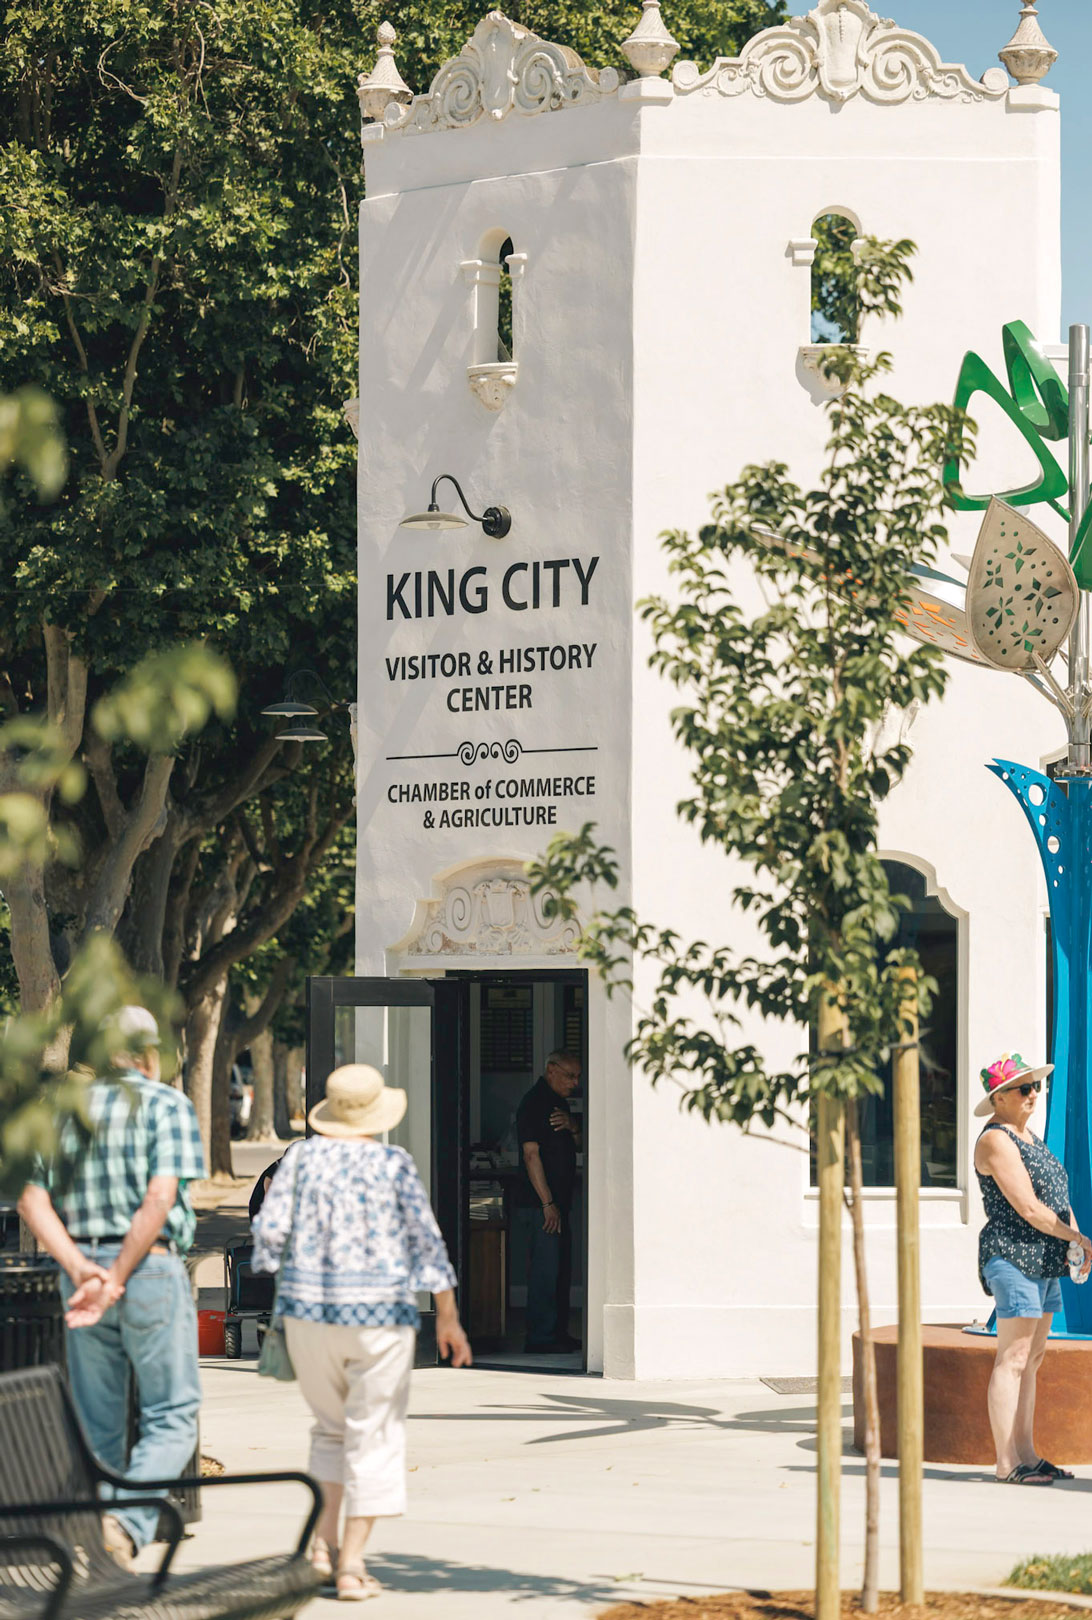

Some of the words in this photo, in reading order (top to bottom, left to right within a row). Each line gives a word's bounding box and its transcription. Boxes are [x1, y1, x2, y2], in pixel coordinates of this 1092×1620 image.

[387, 566, 488, 620] KING
[502, 557, 599, 611] CITY
[386, 652, 471, 681] VISITOR
[477, 651, 493, 675] &
[500, 643, 597, 673] HISTORY
[447, 684, 532, 712] CENTER
[388, 782, 470, 803] CHAMBER
[475, 780, 491, 799] of
[495, 776, 595, 798] COMMERCE
[423, 810, 435, 829] &
[439, 806, 556, 828] AGRICULTURE
